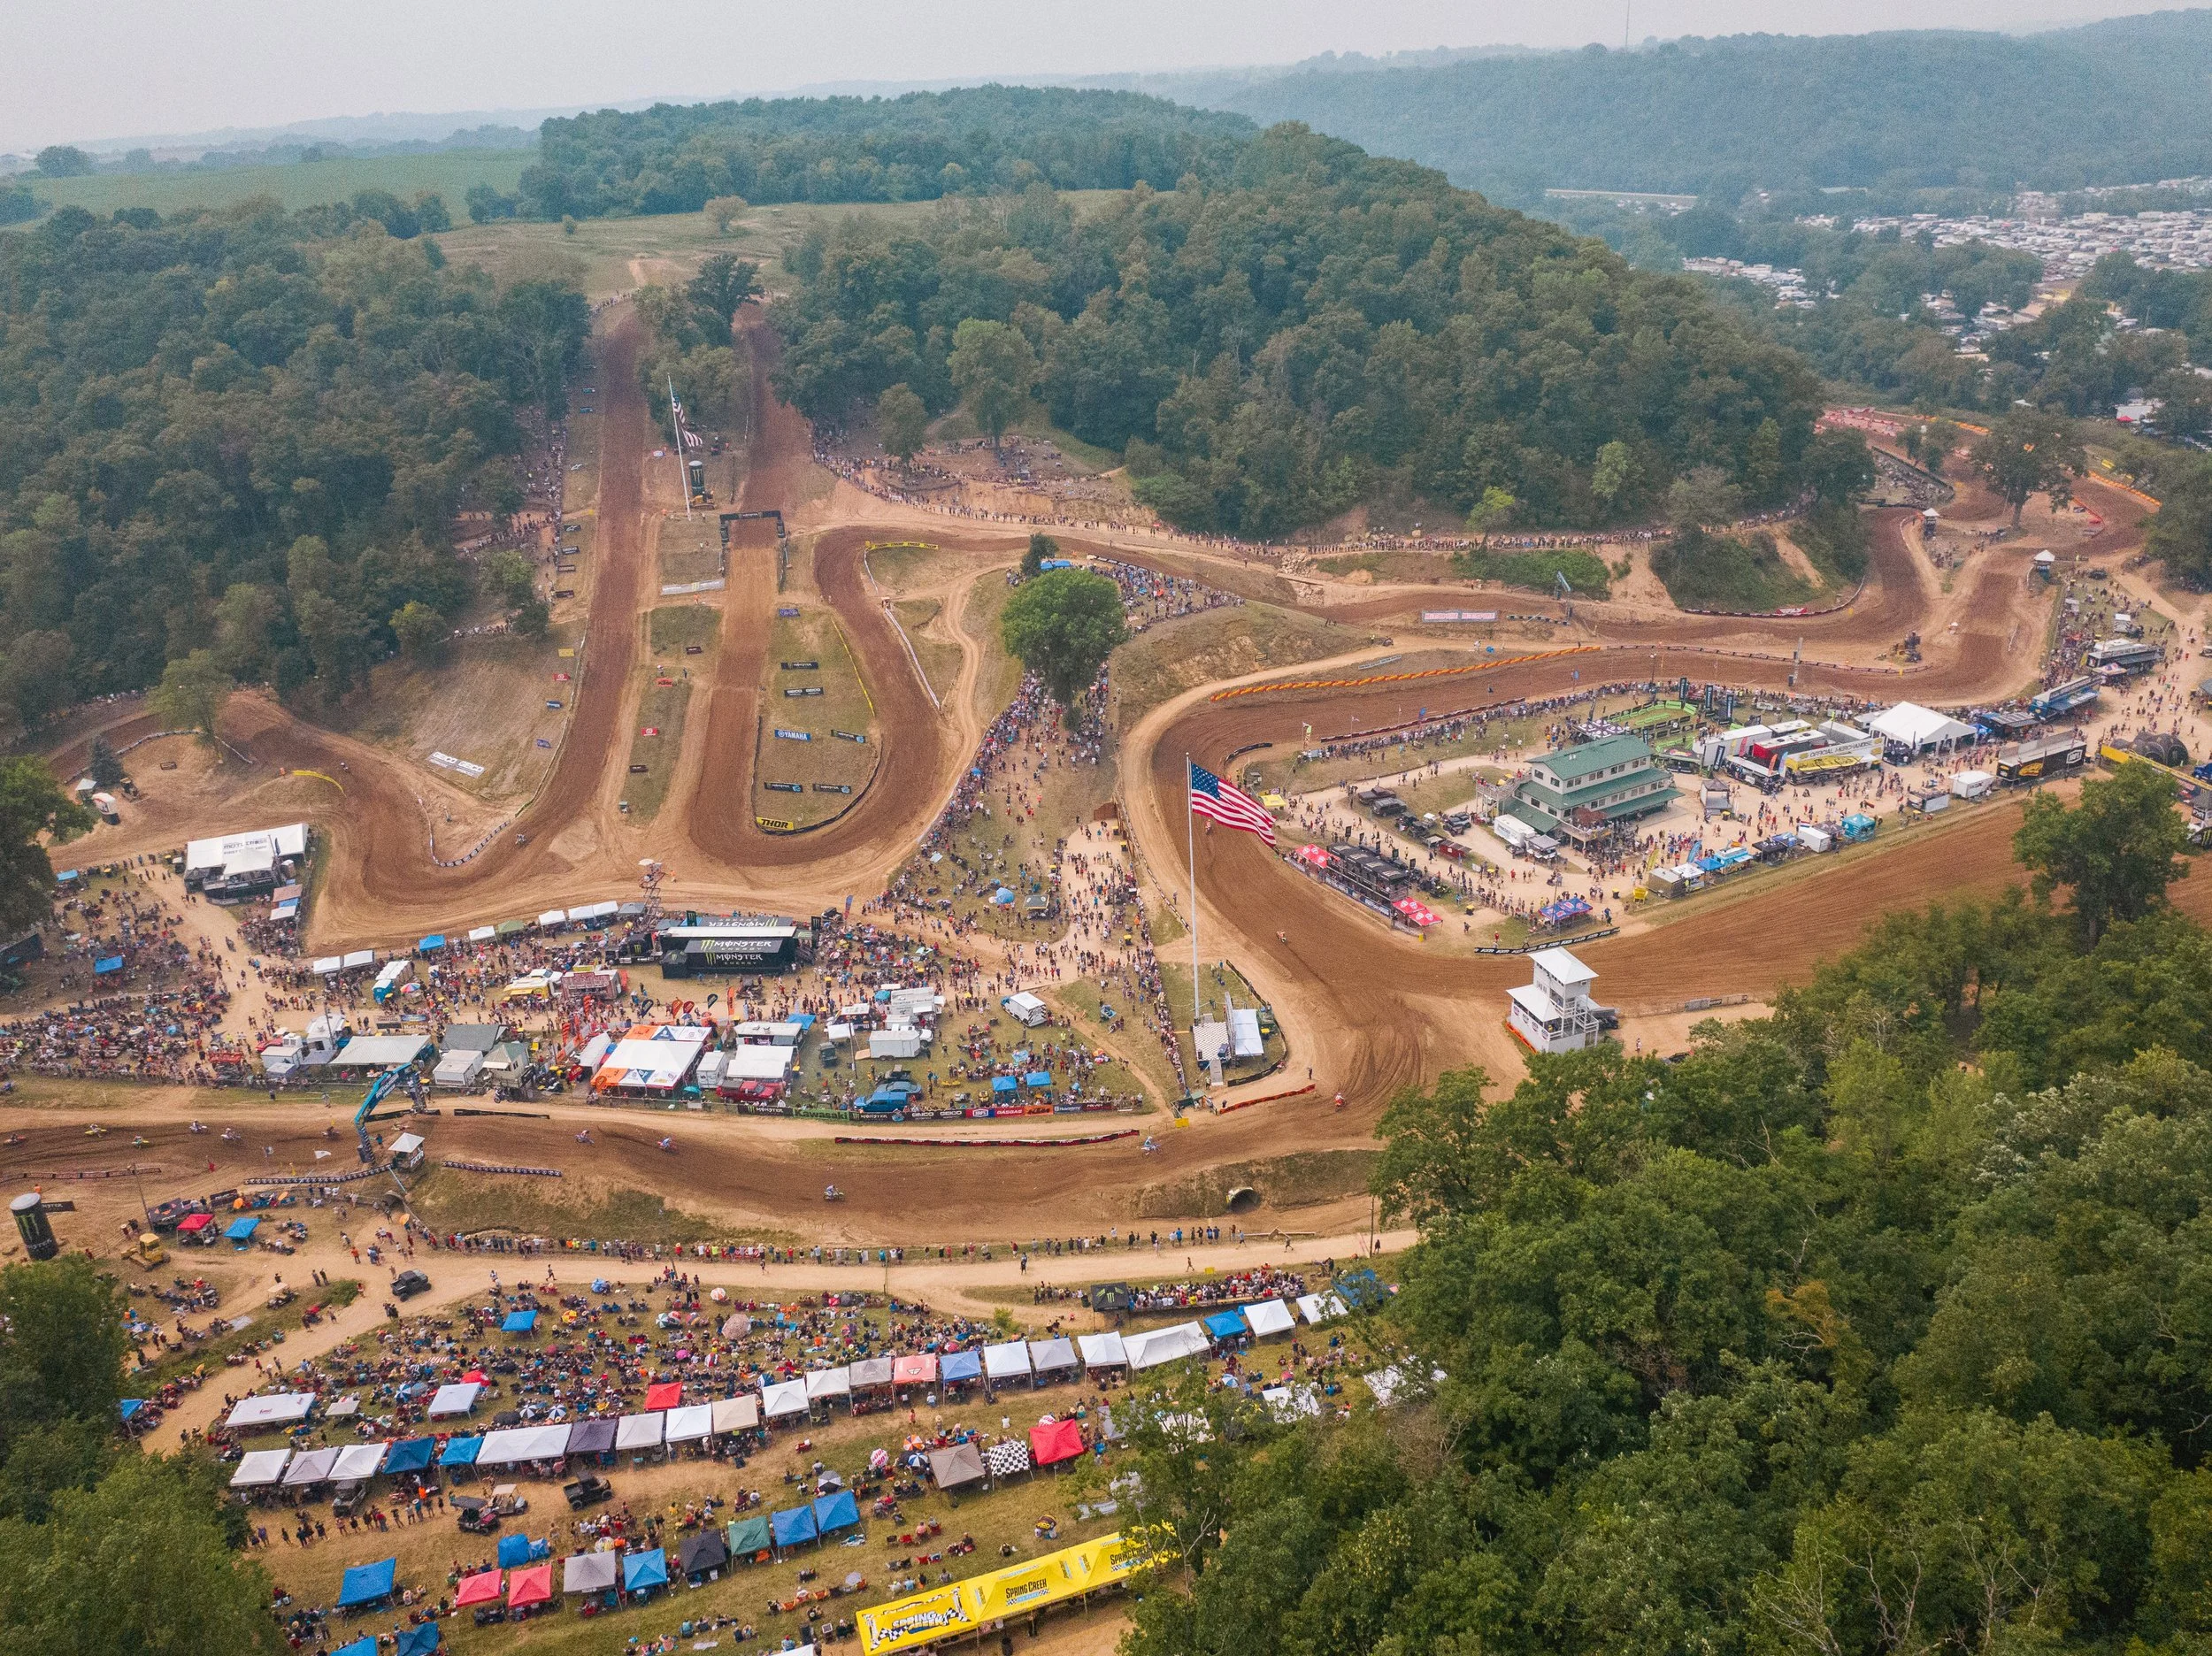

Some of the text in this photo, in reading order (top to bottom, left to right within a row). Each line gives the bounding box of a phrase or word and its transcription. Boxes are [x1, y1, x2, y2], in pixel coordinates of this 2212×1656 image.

[784, 732, 808, 740] YAMAHA
[1809, 748, 1833, 758] OFFICIAL
[761, 818, 789, 829] THOR
[716, 953, 763, 962] MONSTER
[795, 1108, 849, 1120] Kawasaki
[1005, 1583, 1028, 1599] SPRING
[1027, 1578, 1048, 1592] CREEK
[892, 1610, 938, 1629] SPRING
